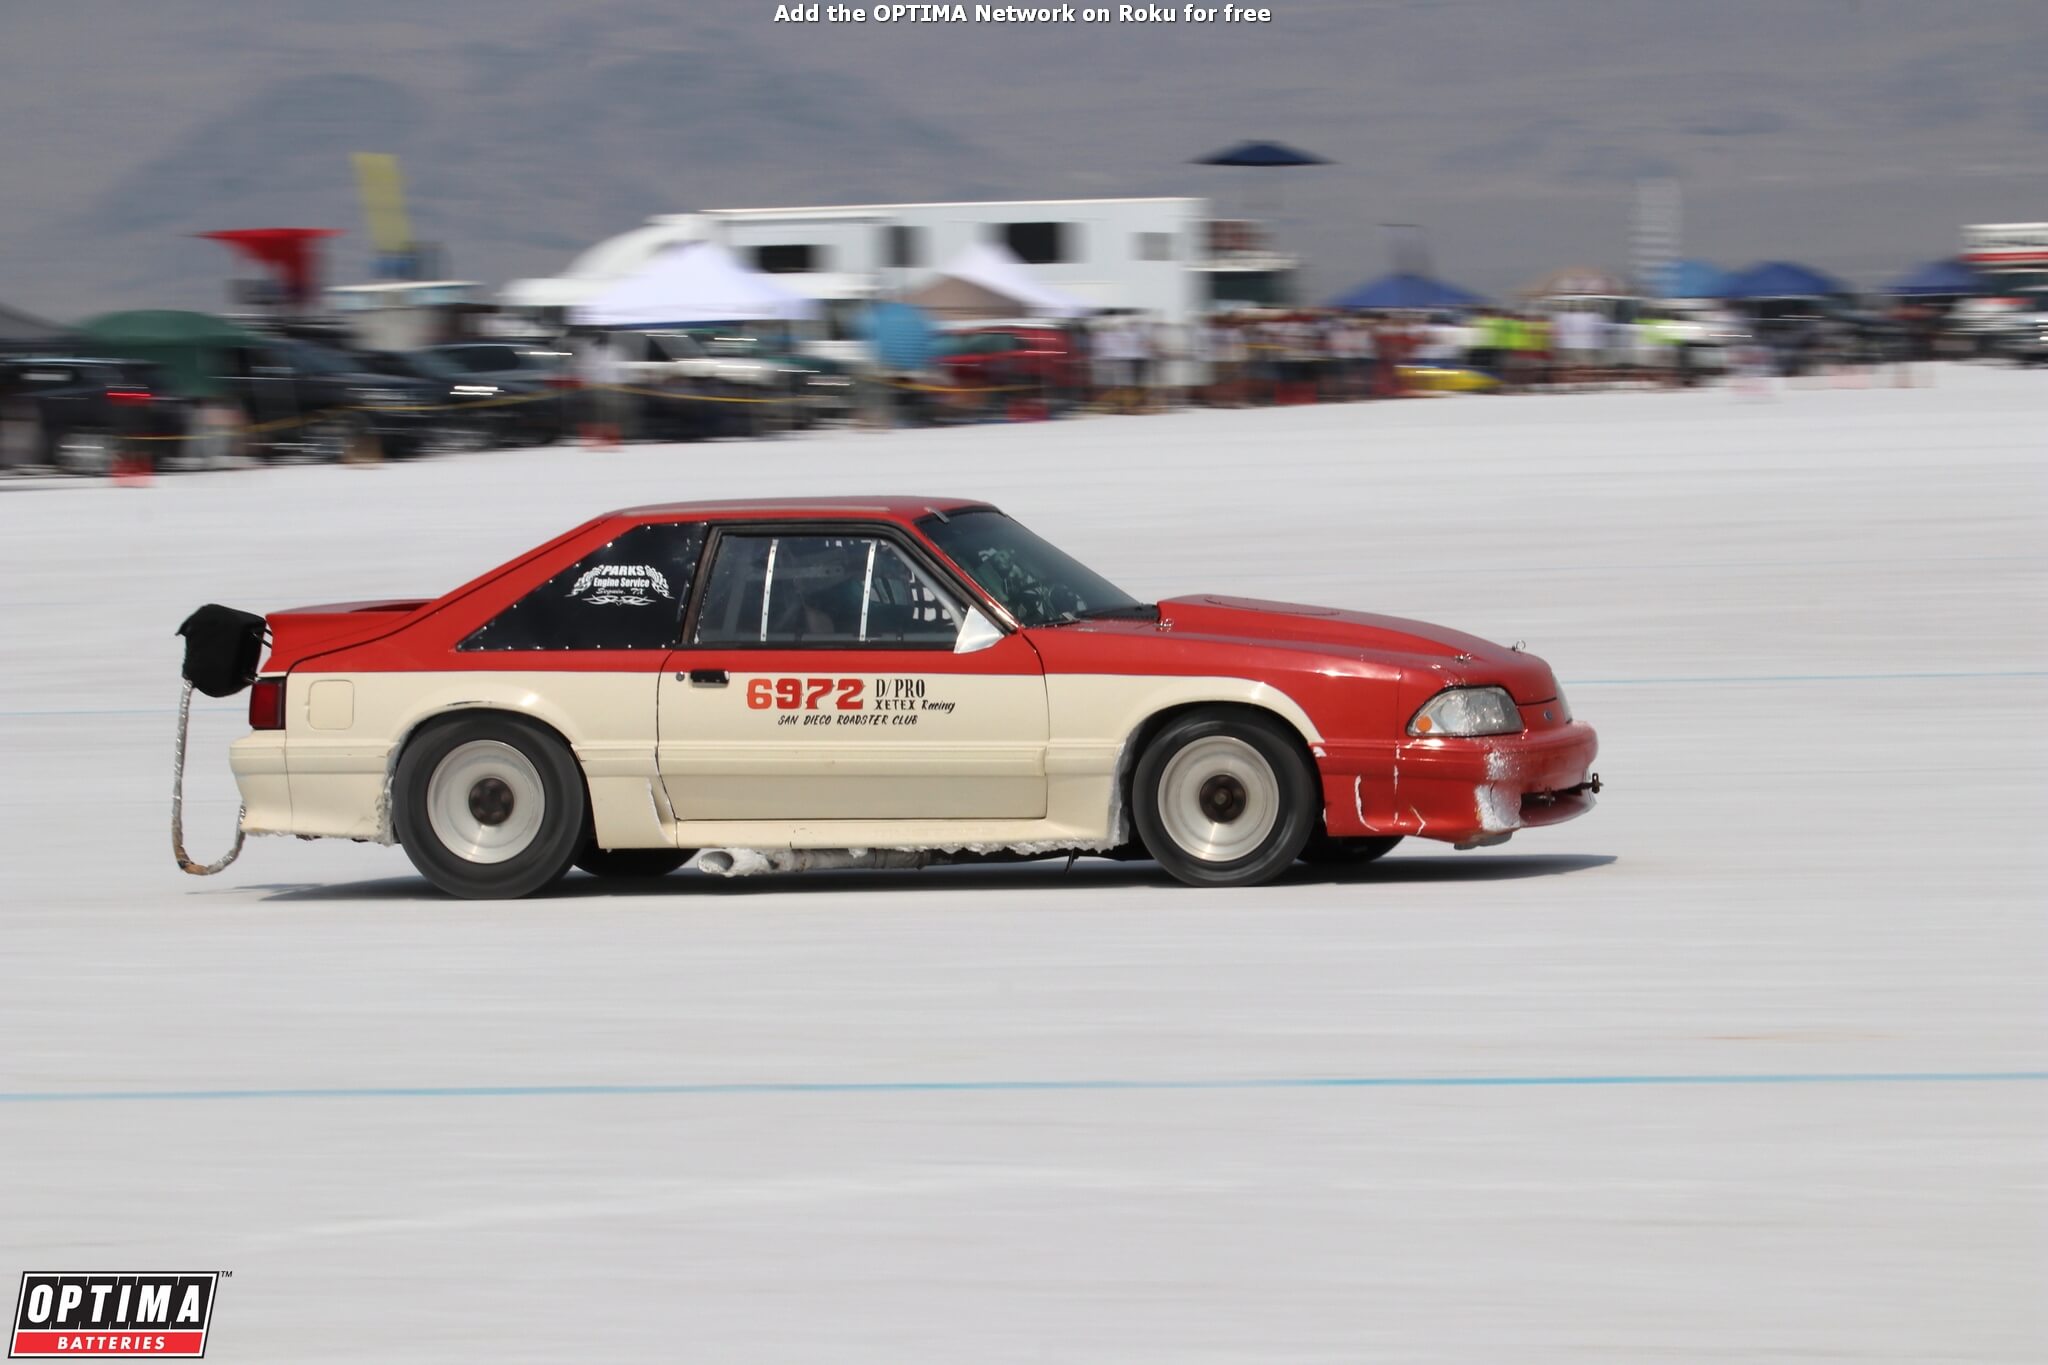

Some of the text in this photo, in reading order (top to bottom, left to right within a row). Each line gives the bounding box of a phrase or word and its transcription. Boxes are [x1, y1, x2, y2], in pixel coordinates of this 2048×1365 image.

[593, 577, 650, 588] Engine Service
[746, 678, 866, 710] 6972
[874, 699, 956, 715] XETEX Racing
[777, 714, 798, 725] SAN
[836, 714, 889, 725] ROADSTER
[892, 714, 919, 725] CLUB
